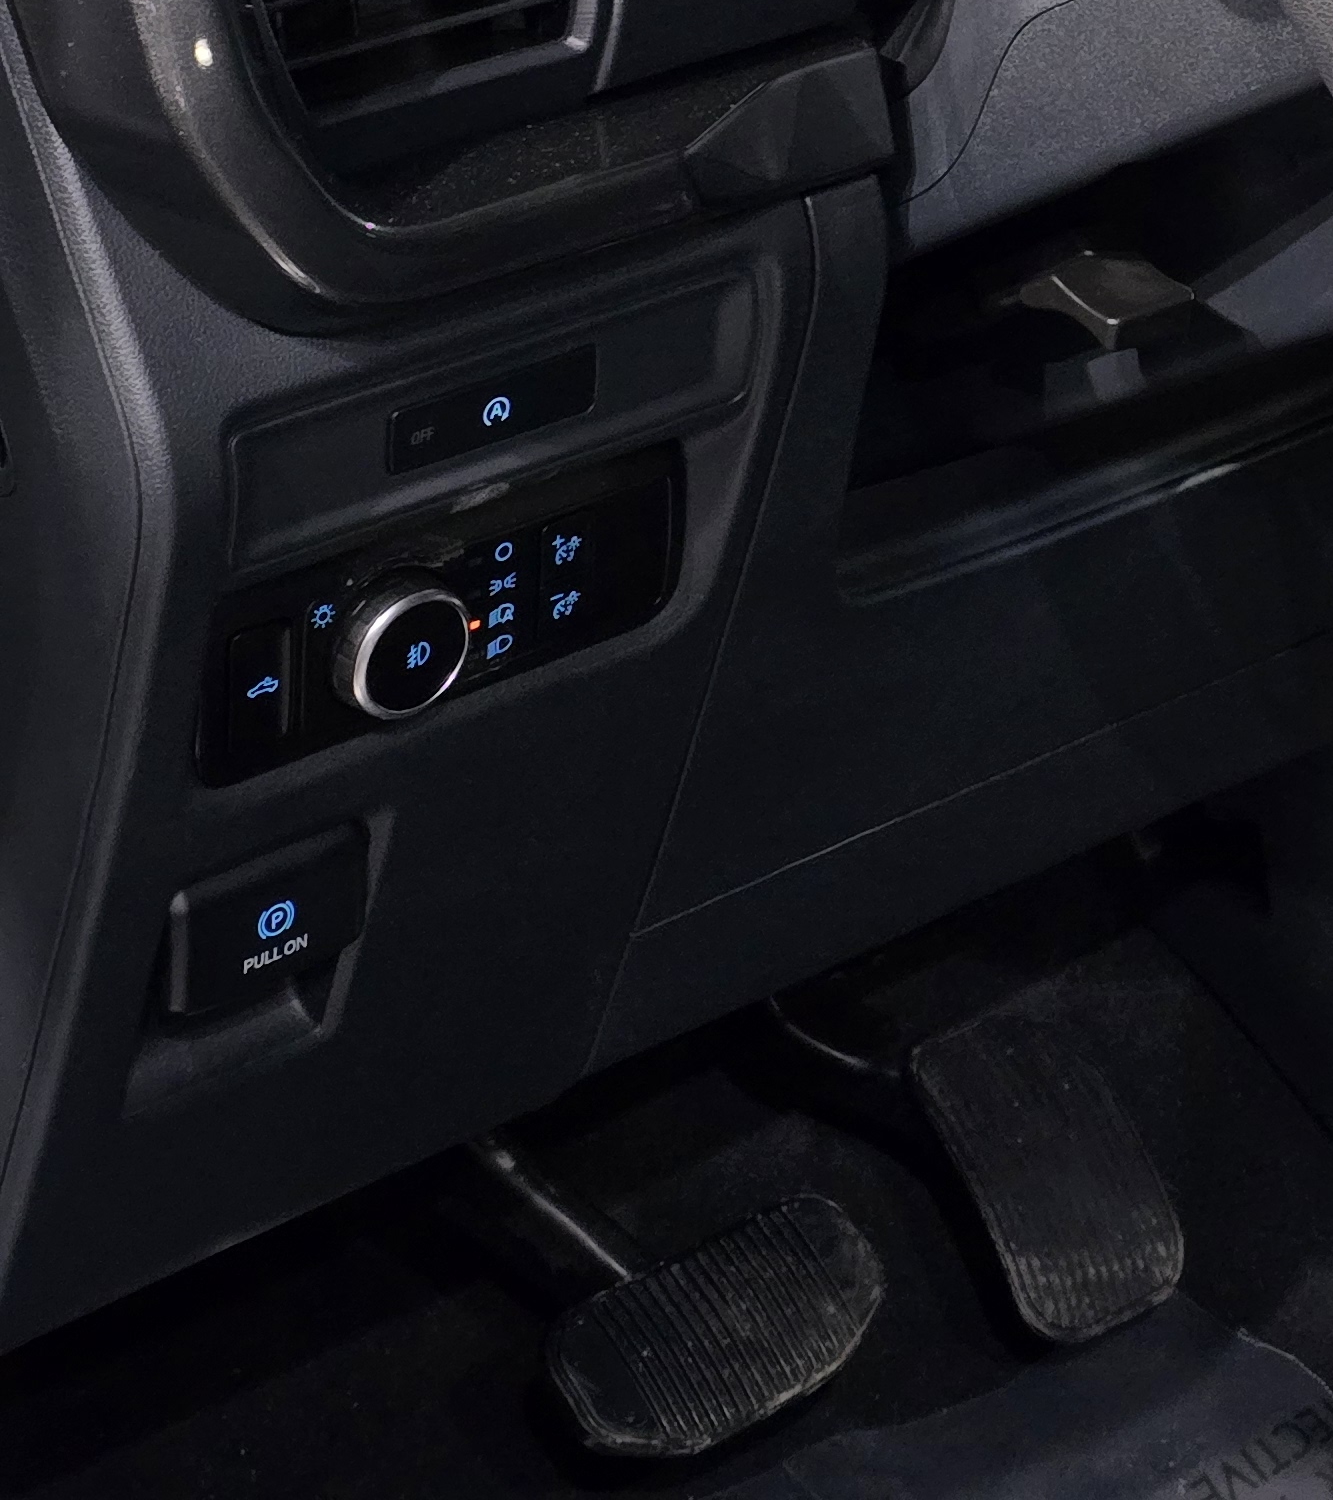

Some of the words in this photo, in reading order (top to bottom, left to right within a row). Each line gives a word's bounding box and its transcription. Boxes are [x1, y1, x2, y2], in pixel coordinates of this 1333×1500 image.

[411, 426, 435, 446] OFF
[243, 947, 283, 974] PULL
[284, 933, 308, 955] ON
